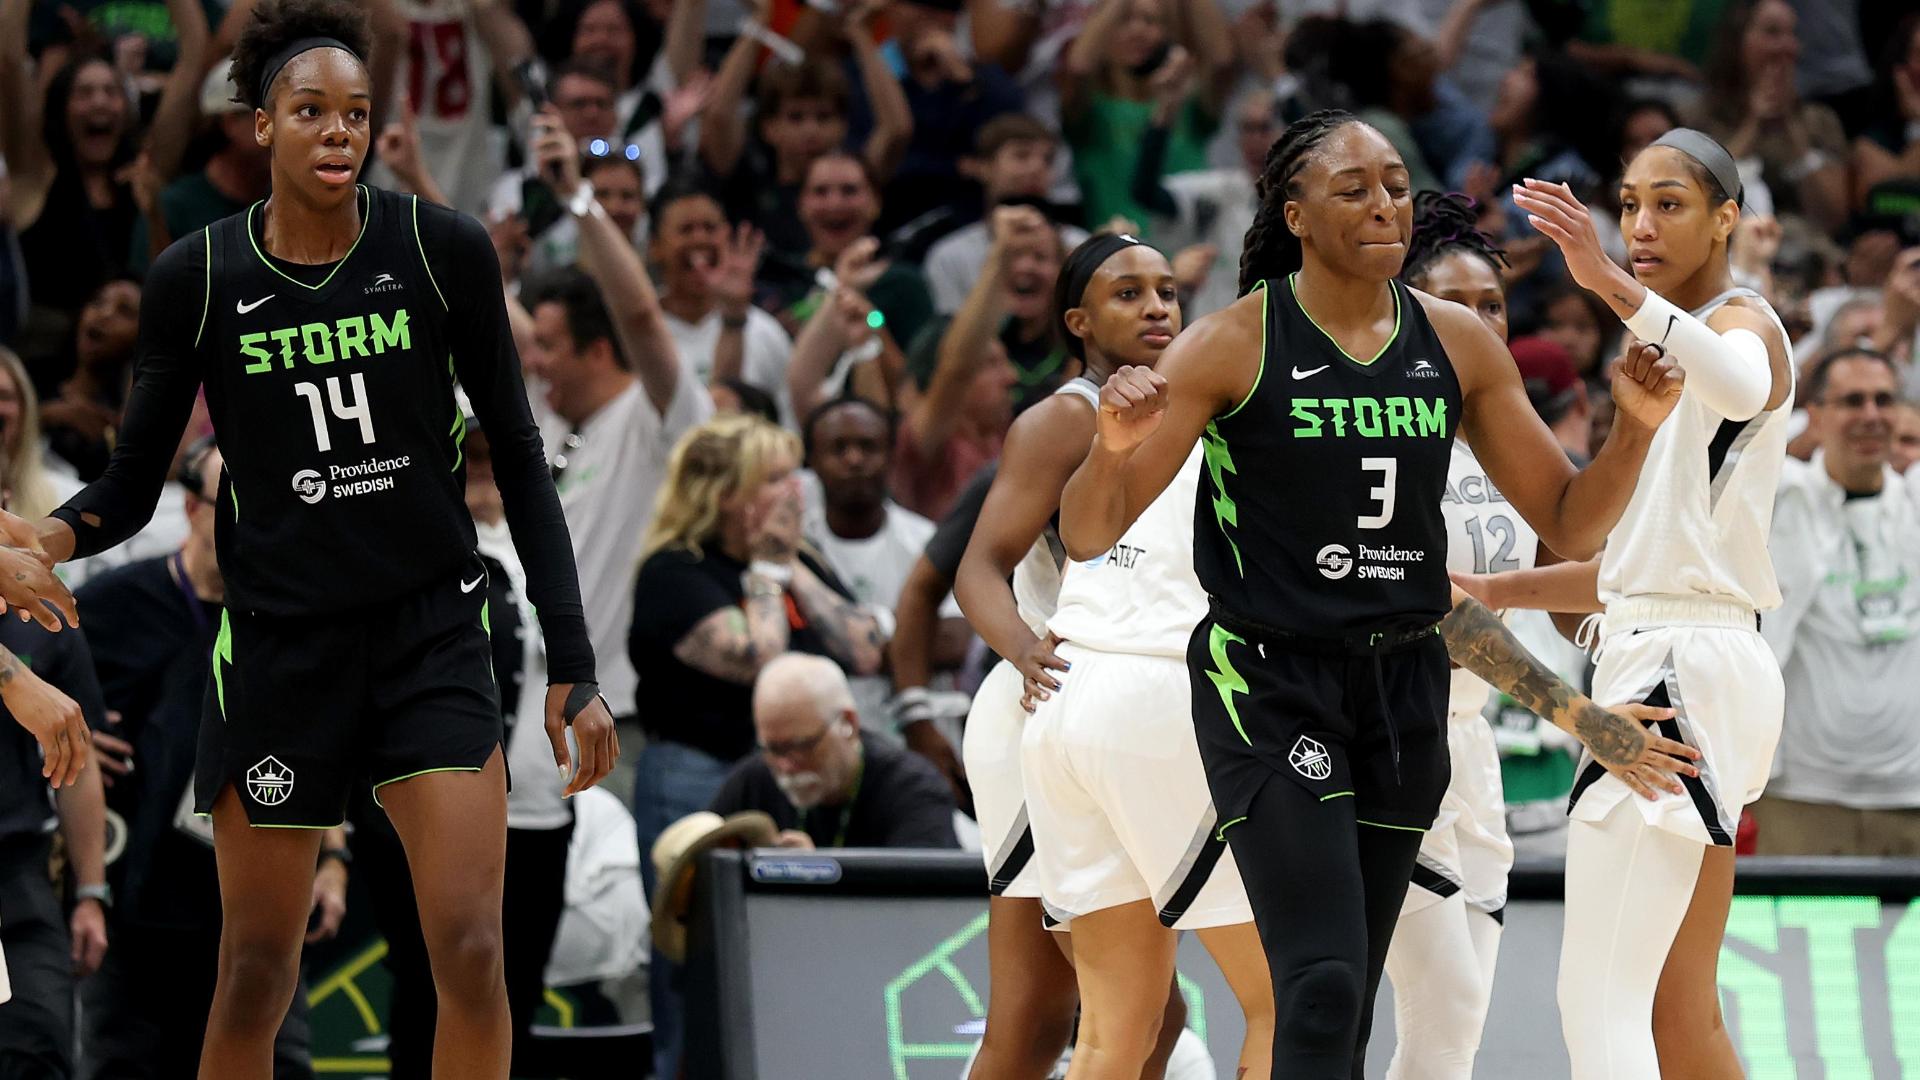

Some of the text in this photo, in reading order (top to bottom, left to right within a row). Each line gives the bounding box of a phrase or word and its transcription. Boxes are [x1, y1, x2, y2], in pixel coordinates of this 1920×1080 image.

[364, 283, 404, 295] SYMETRA
[240, 309, 412, 374] STORM
[1406, 370, 1440, 378] SYMETRA
[295, 373, 376, 452] 14
[1289, 397, 1448, 438] STORM
[329, 455, 411, 480] Providence
[333, 477, 394, 498] SWEDISH
[1357, 457, 1397, 529] 3
[1107, 544, 1146, 569] AT&T
[1358, 544, 1424, 561] Providence
[1465, 515, 1520, 574] 12
[1358, 566, 1405, 580] SWEDISH
